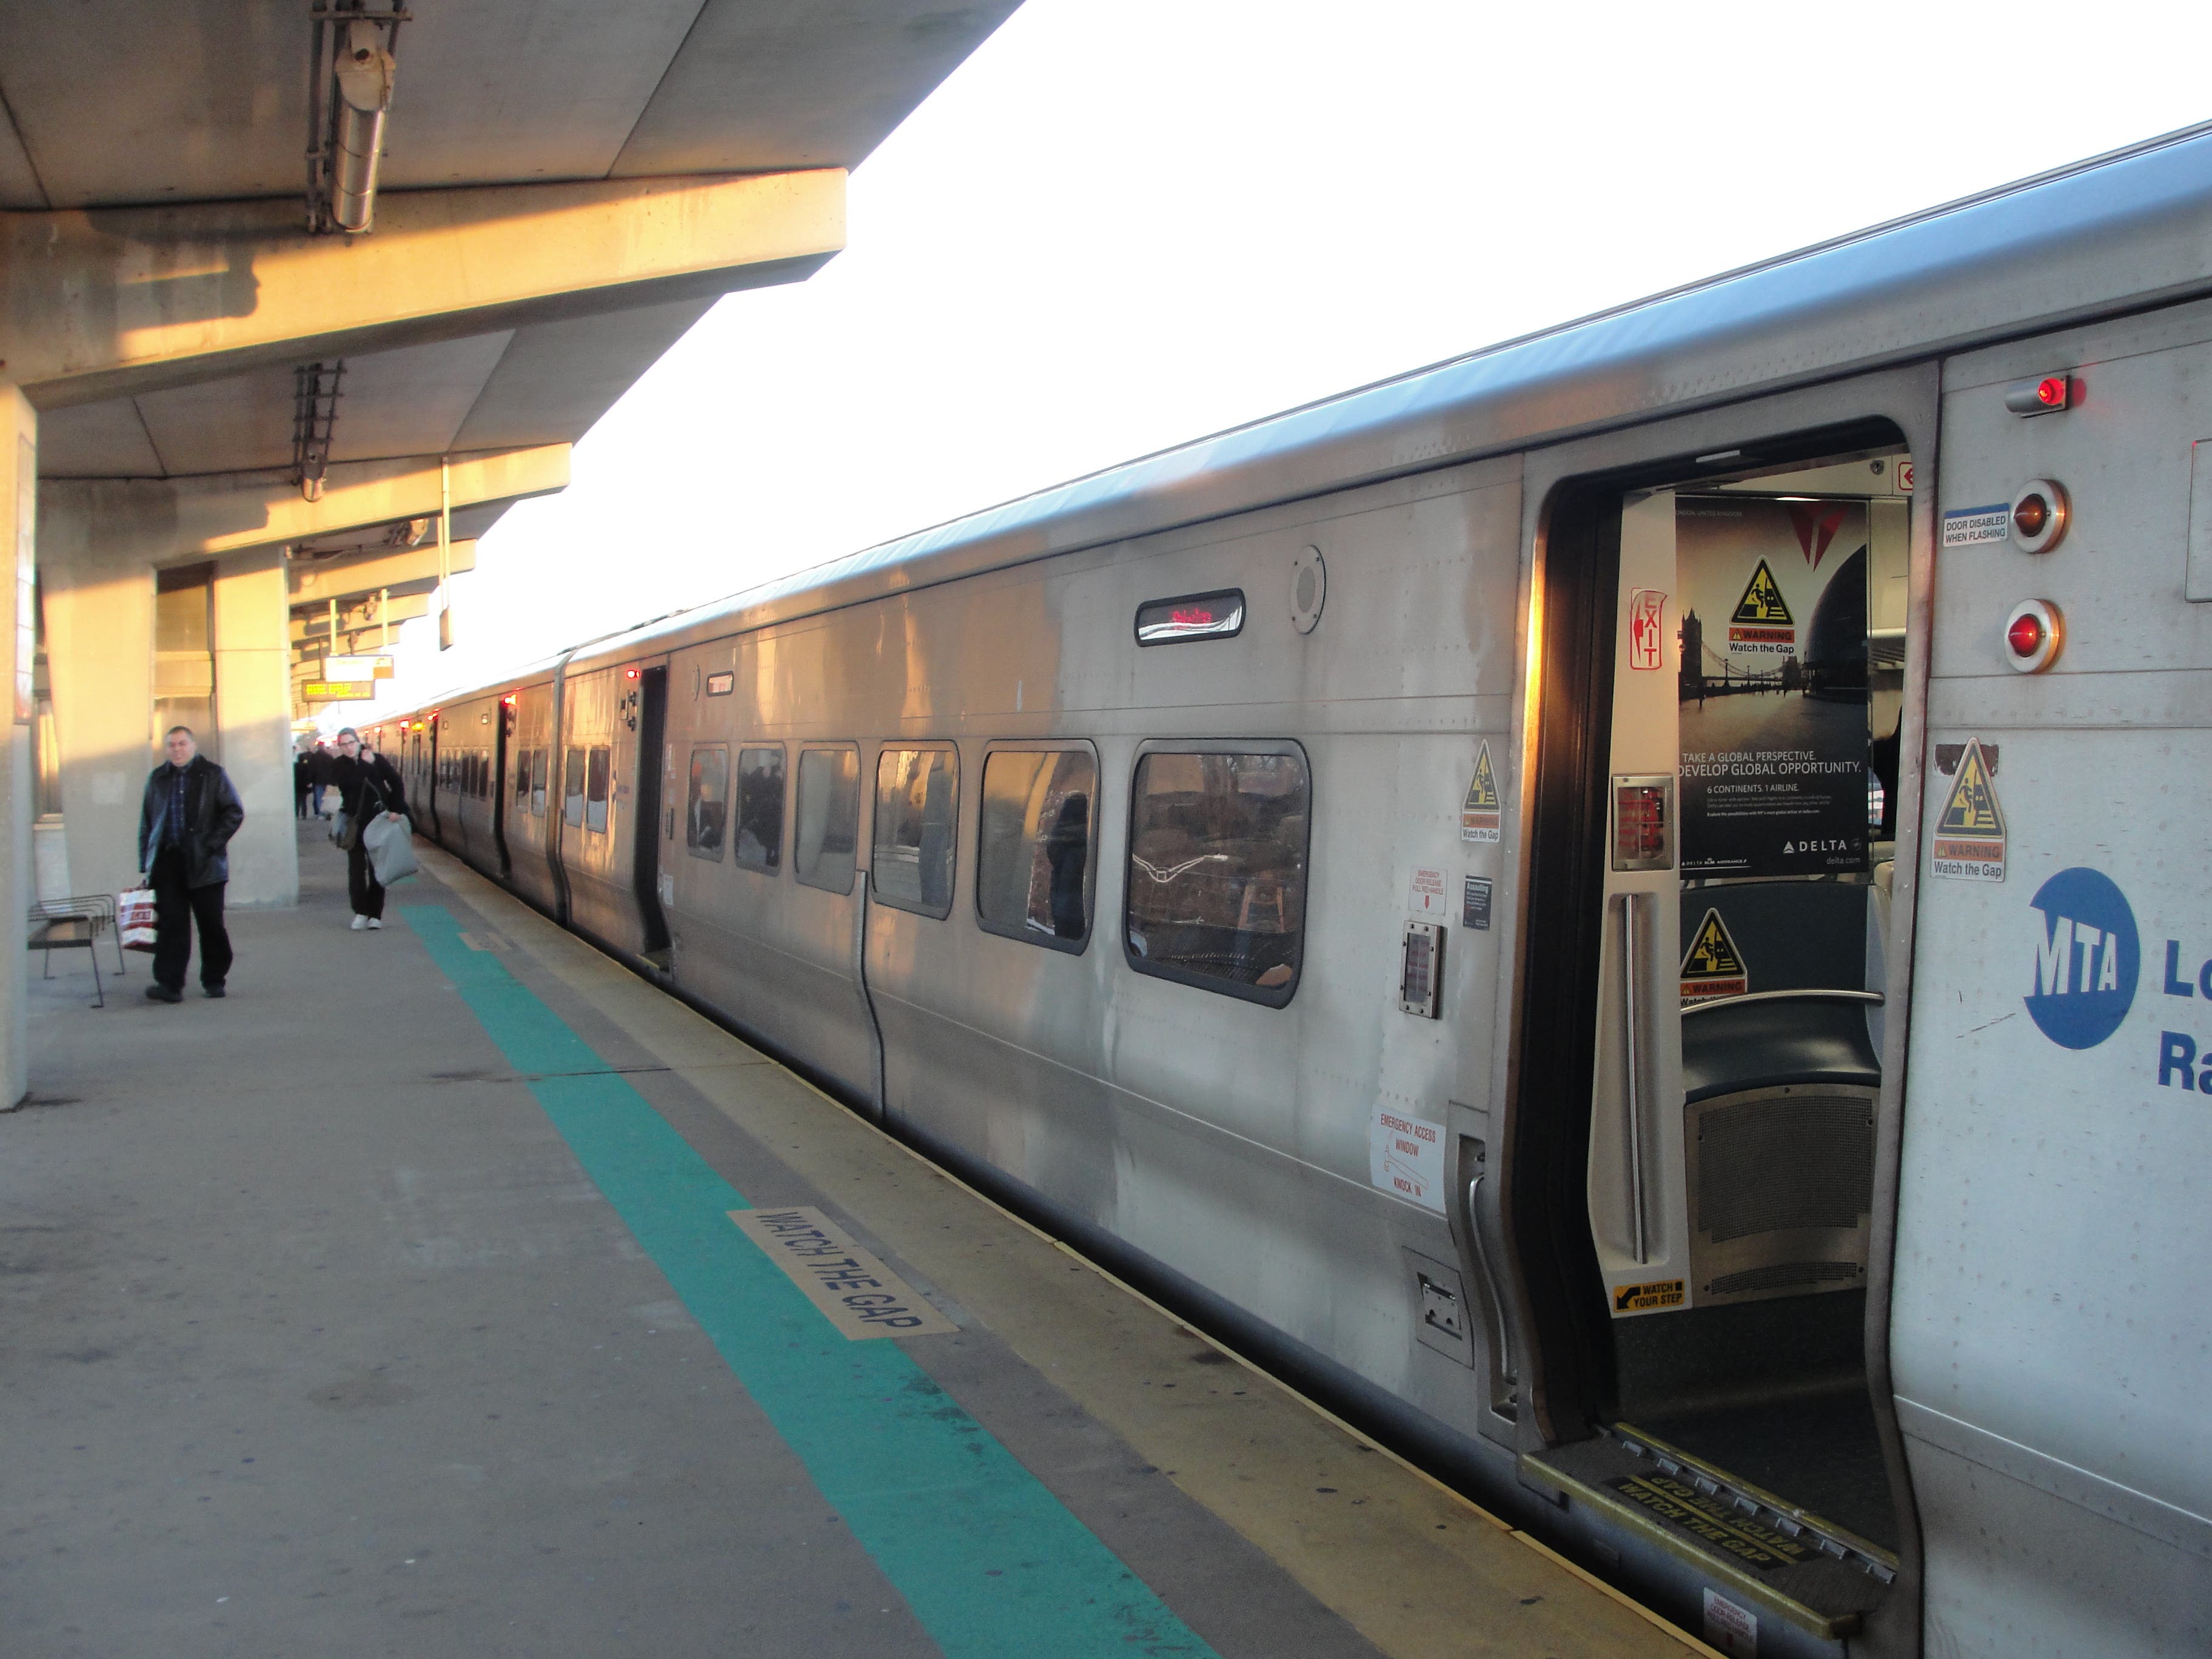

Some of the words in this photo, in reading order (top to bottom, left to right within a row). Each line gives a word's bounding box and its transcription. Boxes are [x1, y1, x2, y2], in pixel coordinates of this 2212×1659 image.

[1946, 521, 1967, 531] DOOR
[1969, 516, 2006, 528] DISABLED
[1946, 532, 1967, 543] WHEN
[1969, 528, 2005, 540] FLASHING
[1644, 593, 1657, 666] EXIT
[1743, 631, 1792, 640] WARNING
[1729, 643, 1757, 652] Watch
[1776, 645, 1794, 654] Gap
[1683, 752, 1706, 763] TAKE
[1708, 752, 1715, 762] A
[1718, 752, 1754, 762] GLOBAL
[1756, 751, 1816, 761] PERSPECTIVE.
[1731, 763, 1775, 776] GLOBAL
[1778, 761, 1862, 774] OPPORTUNITY.
[1714, 785, 1762, 793] CONTINENTS.
[1470, 817, 1498, 826] WARNING
[1463, 829, 1478, 837] Watch
[1488, 830, 1498, 841] Gap
[1800, 840, 1847, 852] DELTA
[1949, 844, 1999, 857] WARNING
[1934, 861, 1962, 874] Watch
[1965, 863, 1979, 874] the
[1982, 863, 2001, 879] Gap
[2026, 907, 2117, 996] MTA
[1692, 982, 1742, 993] WARNING
[1381, 1113, 1413, 1134] EMERGENCY
[1414, 1125, 1436, 1143] ACCESS
[1395, 1138, 1419, 1157] WINDOW
[1393, 1176, 1412, 1193] KNOCK
[1415, 1185, 1421, 1198] IN
[756, 1212, 844, 1256] WATCH
[806, 1258, 882, 1290] THE
[1643, 1283, 1673, 1294] WATCH
[1634, 1296, 1658, 1307] YOUR
[1661, 1293, 1682, 1304] STEP
[842, 1294, 922, 1328] GAP
[1618, 1483, 1688, 1518] WATCH
[1683, 1517, 1728, 1540] THE
[1722, 1540, 1771, 1561] GAP
